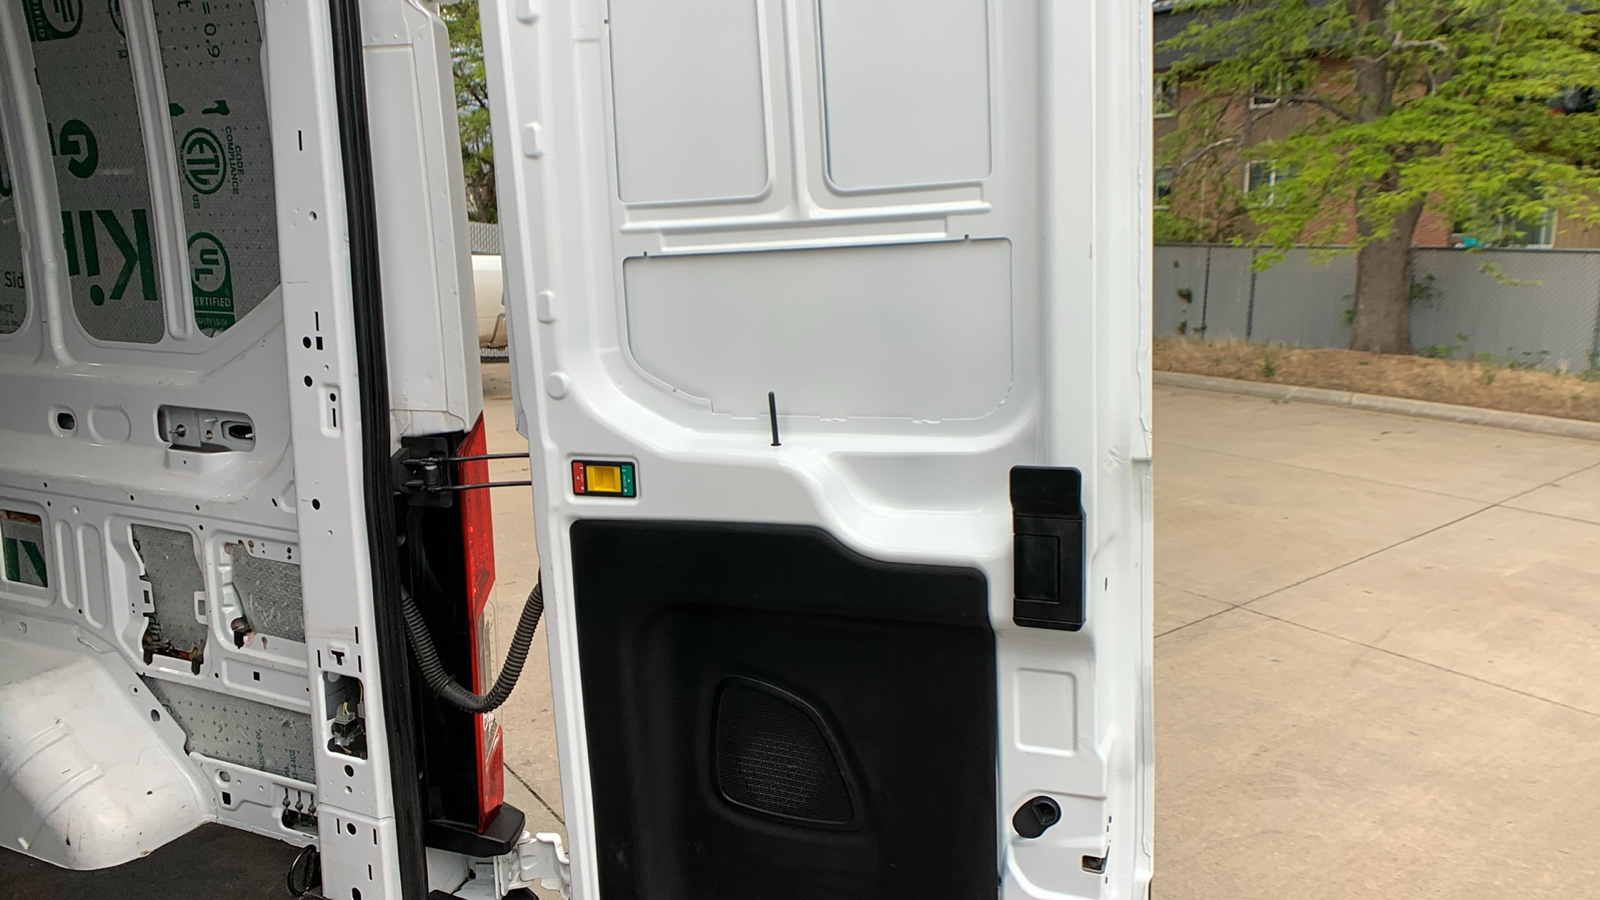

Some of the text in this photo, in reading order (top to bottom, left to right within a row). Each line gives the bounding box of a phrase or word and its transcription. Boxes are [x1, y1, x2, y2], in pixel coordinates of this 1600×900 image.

[204, 22, 219, 58] 0.9
[186, 137, 220, 186] ETL
[225, 126, 240, 195] COMPLIANCE
[234, 145, 245, 176] CODE
[192, 194, 201, 210] US
[193, 248, 220, 282] UL
